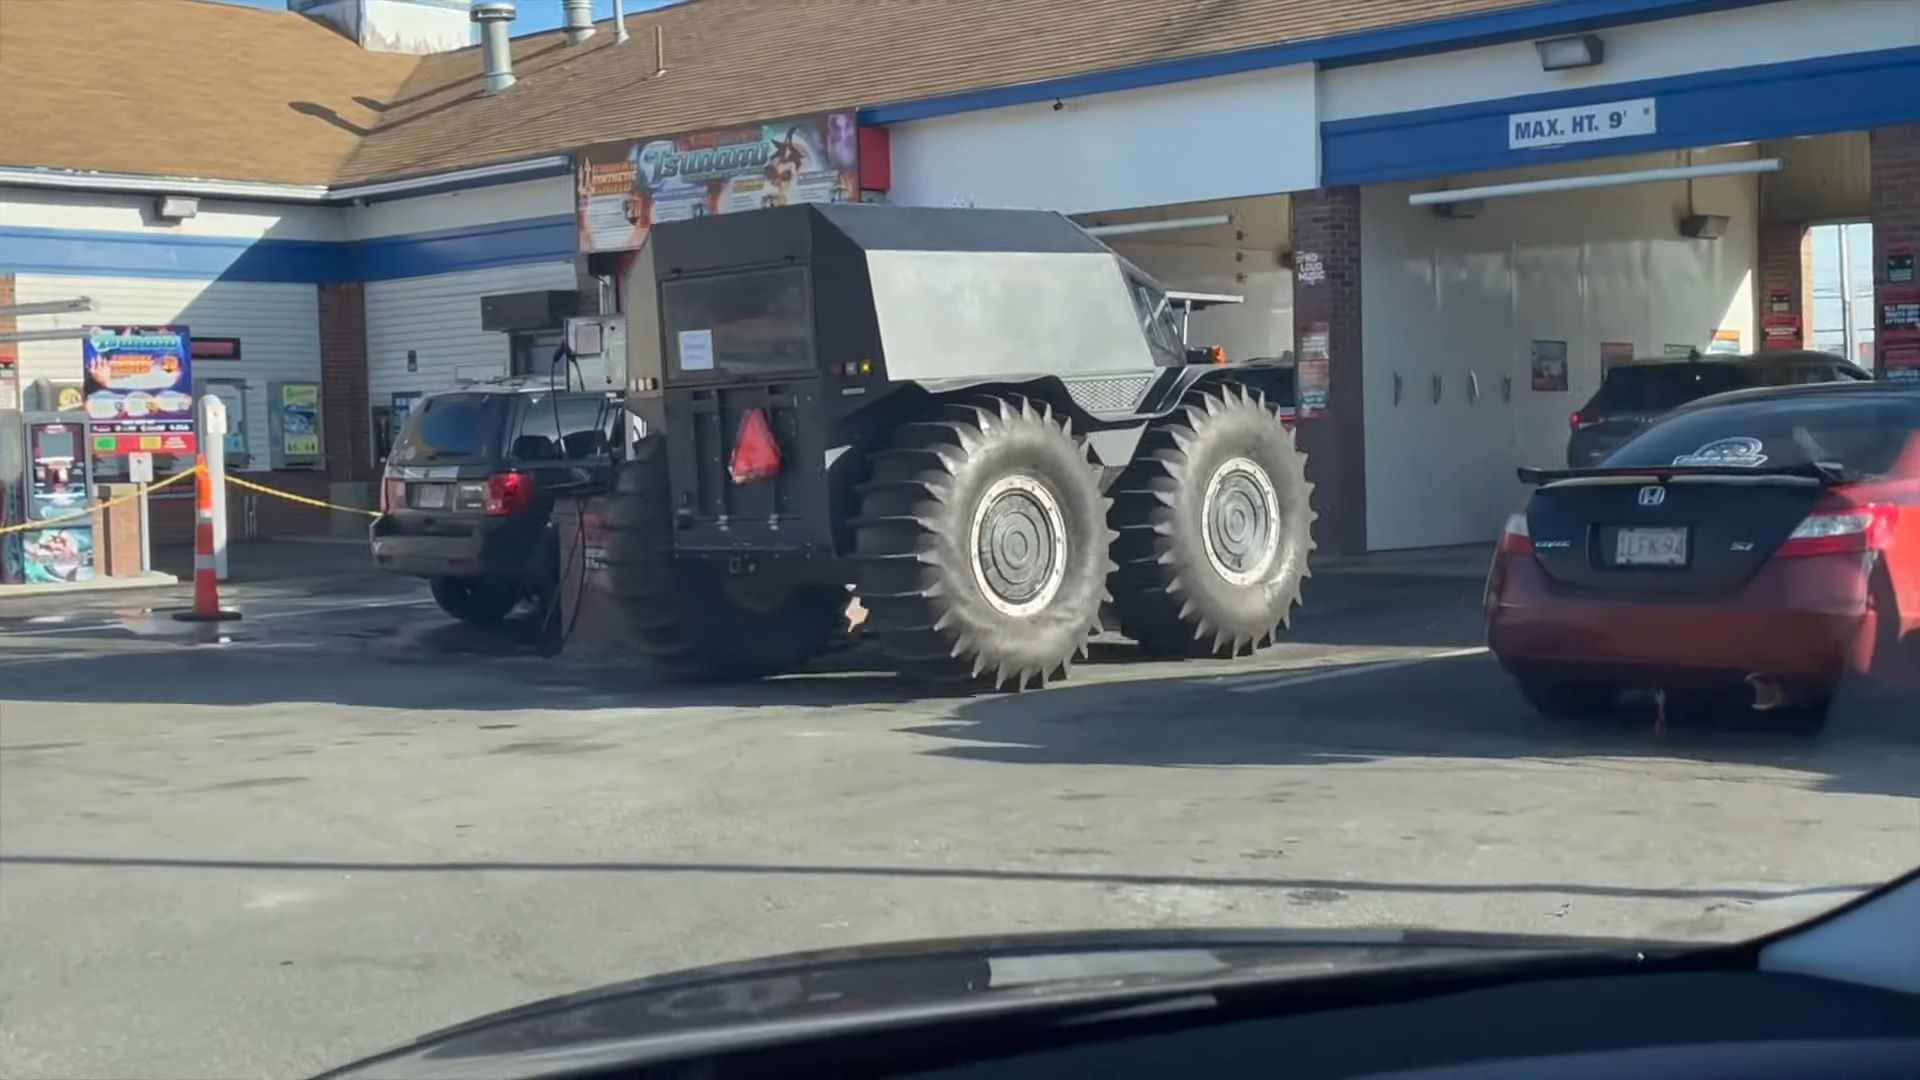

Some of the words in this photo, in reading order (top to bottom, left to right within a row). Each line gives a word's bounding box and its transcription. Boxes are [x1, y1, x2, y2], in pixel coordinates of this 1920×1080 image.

[1515, 118, 1565, 141] MAX.
[1571, 114, 1600, 134] HT.
[643, 142, 770, 185] Tsunami
